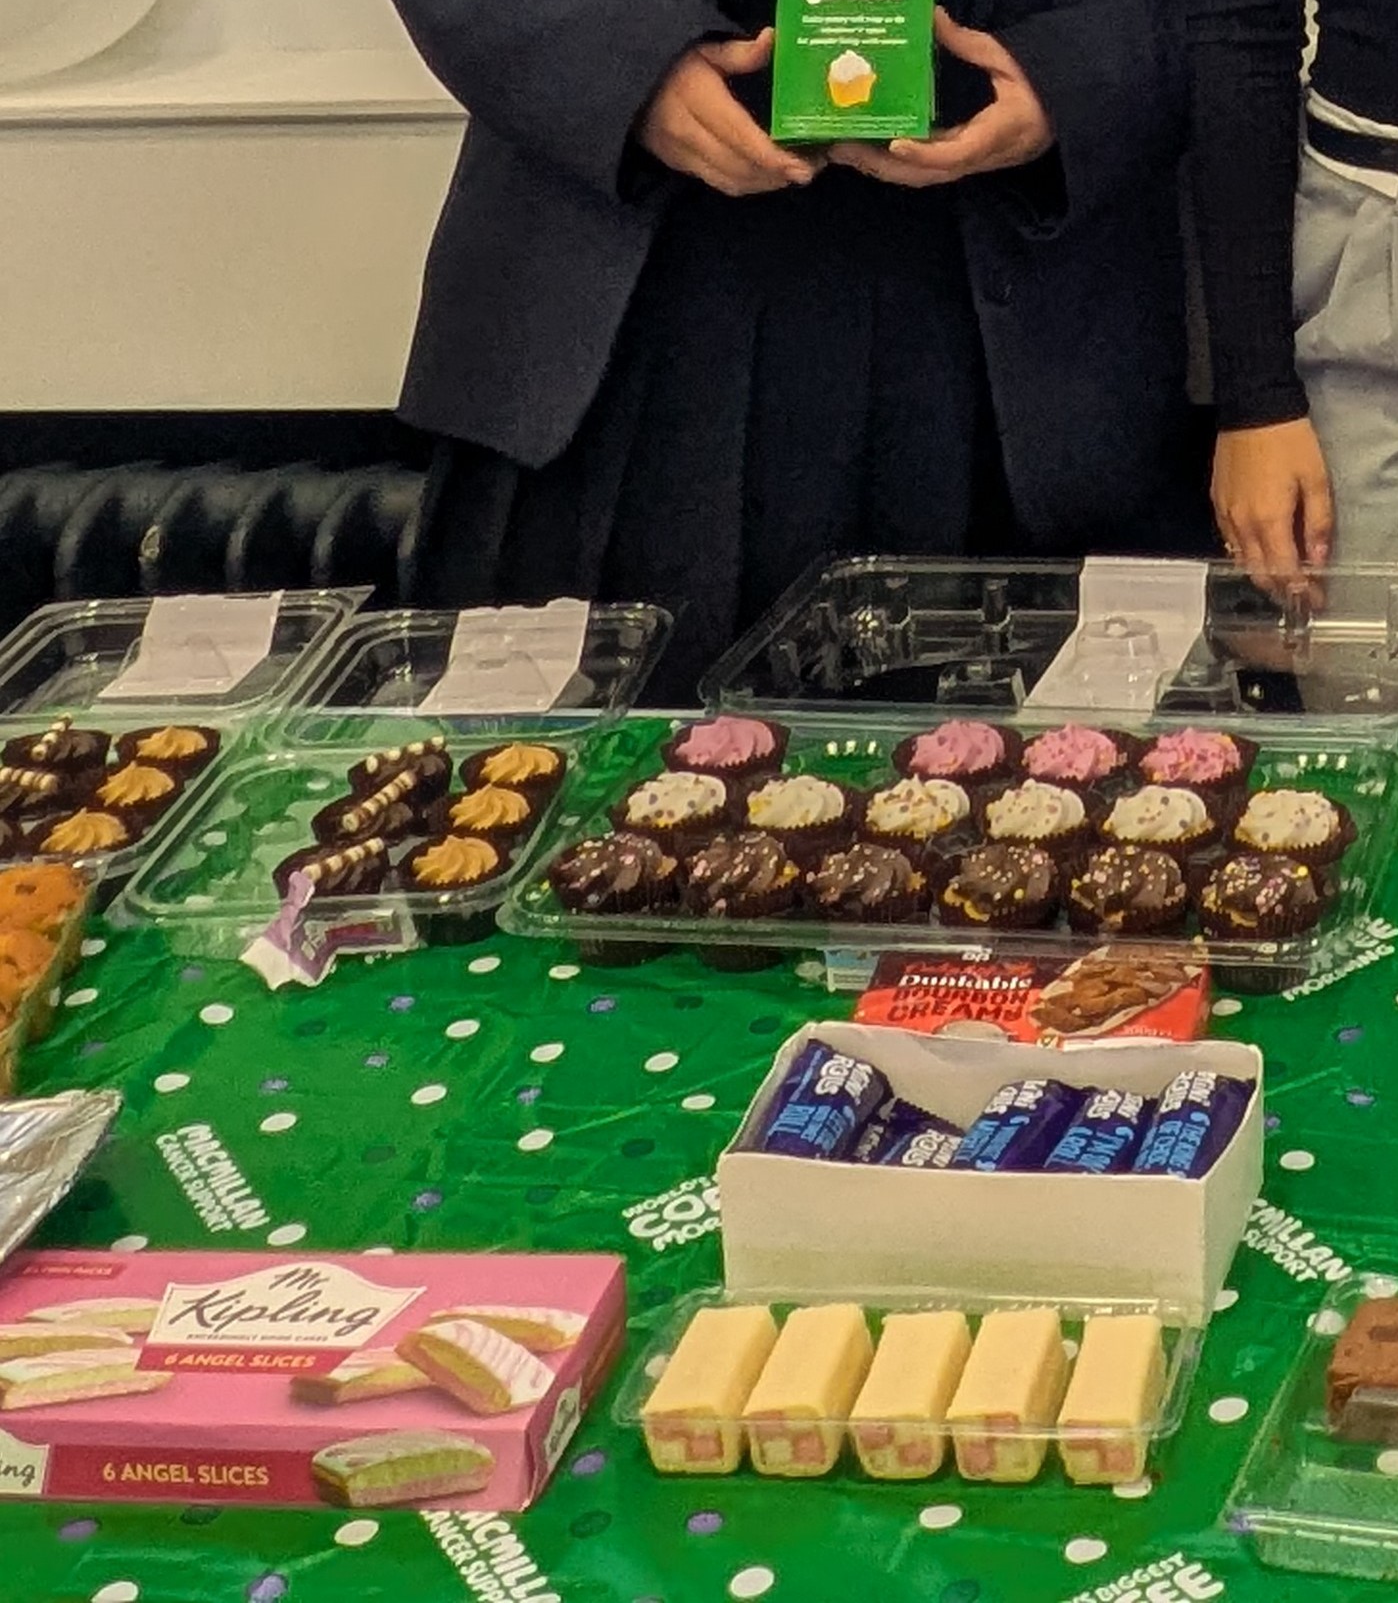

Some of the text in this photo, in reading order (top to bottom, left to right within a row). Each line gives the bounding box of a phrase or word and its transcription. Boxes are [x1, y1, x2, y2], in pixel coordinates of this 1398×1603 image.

[899, 973, 1033, 991] Dunkable
[1282, 943, 1396, 1001] MORNING
[156, 1134, 233, 1233] CANCER SUPPORT
[177, 1124, 270, 1230] MACMILLAN
[268, 1266, 330, 1291] Mr
[168, 1289, 381, 1338] Kipling
[163, 1352, 318, 1368] 6 ANGEL SLICES
[102, 1462, 270, 1486] 6 ANGEL SLICES
[1094, 1551, 1185, 1602] BIGGEST
